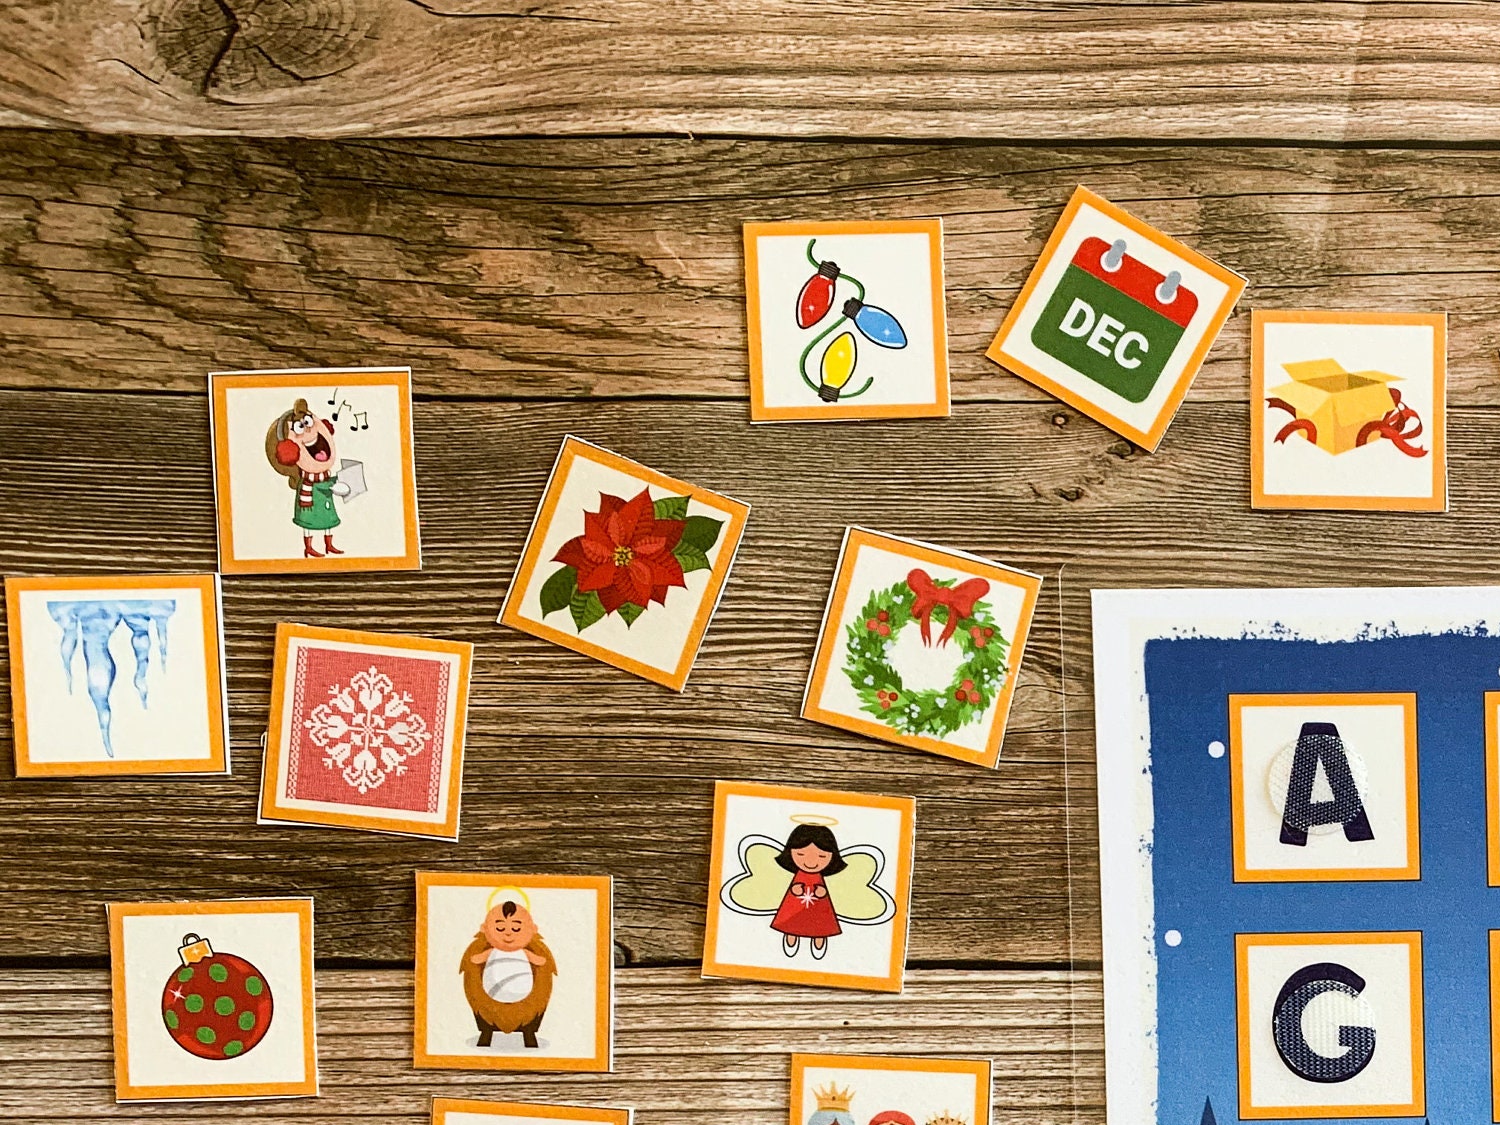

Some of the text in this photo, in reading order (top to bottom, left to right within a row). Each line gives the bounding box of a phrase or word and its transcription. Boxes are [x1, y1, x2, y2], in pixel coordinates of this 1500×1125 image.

[1058, 297, 1149, 369] DEC
[1279, 723, 1374, 846] A
[1272, 963, 1376, 1083] G
